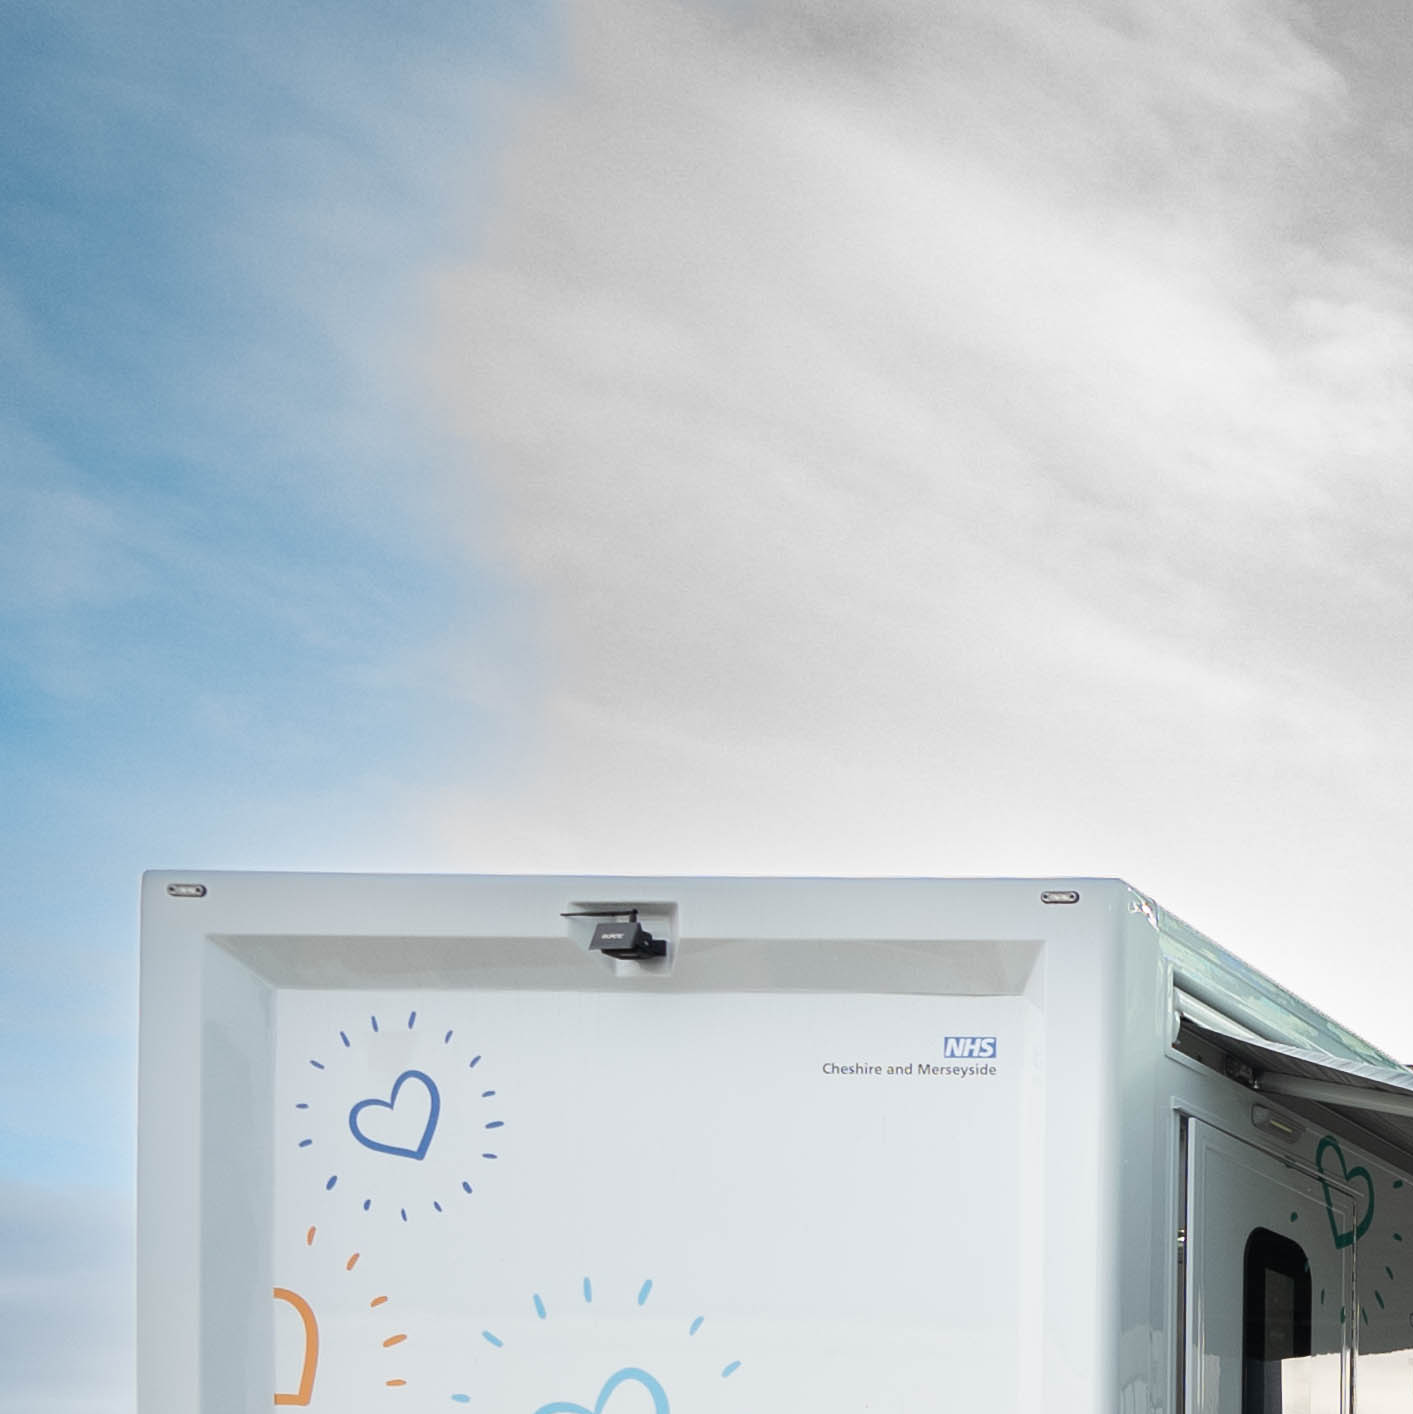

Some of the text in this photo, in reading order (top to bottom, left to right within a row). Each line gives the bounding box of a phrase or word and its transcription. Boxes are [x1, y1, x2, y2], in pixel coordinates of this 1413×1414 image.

[945, 1038, 994, 1057] NHS
[822, 1063, 997, 1078] Cheshire and Merseyside
